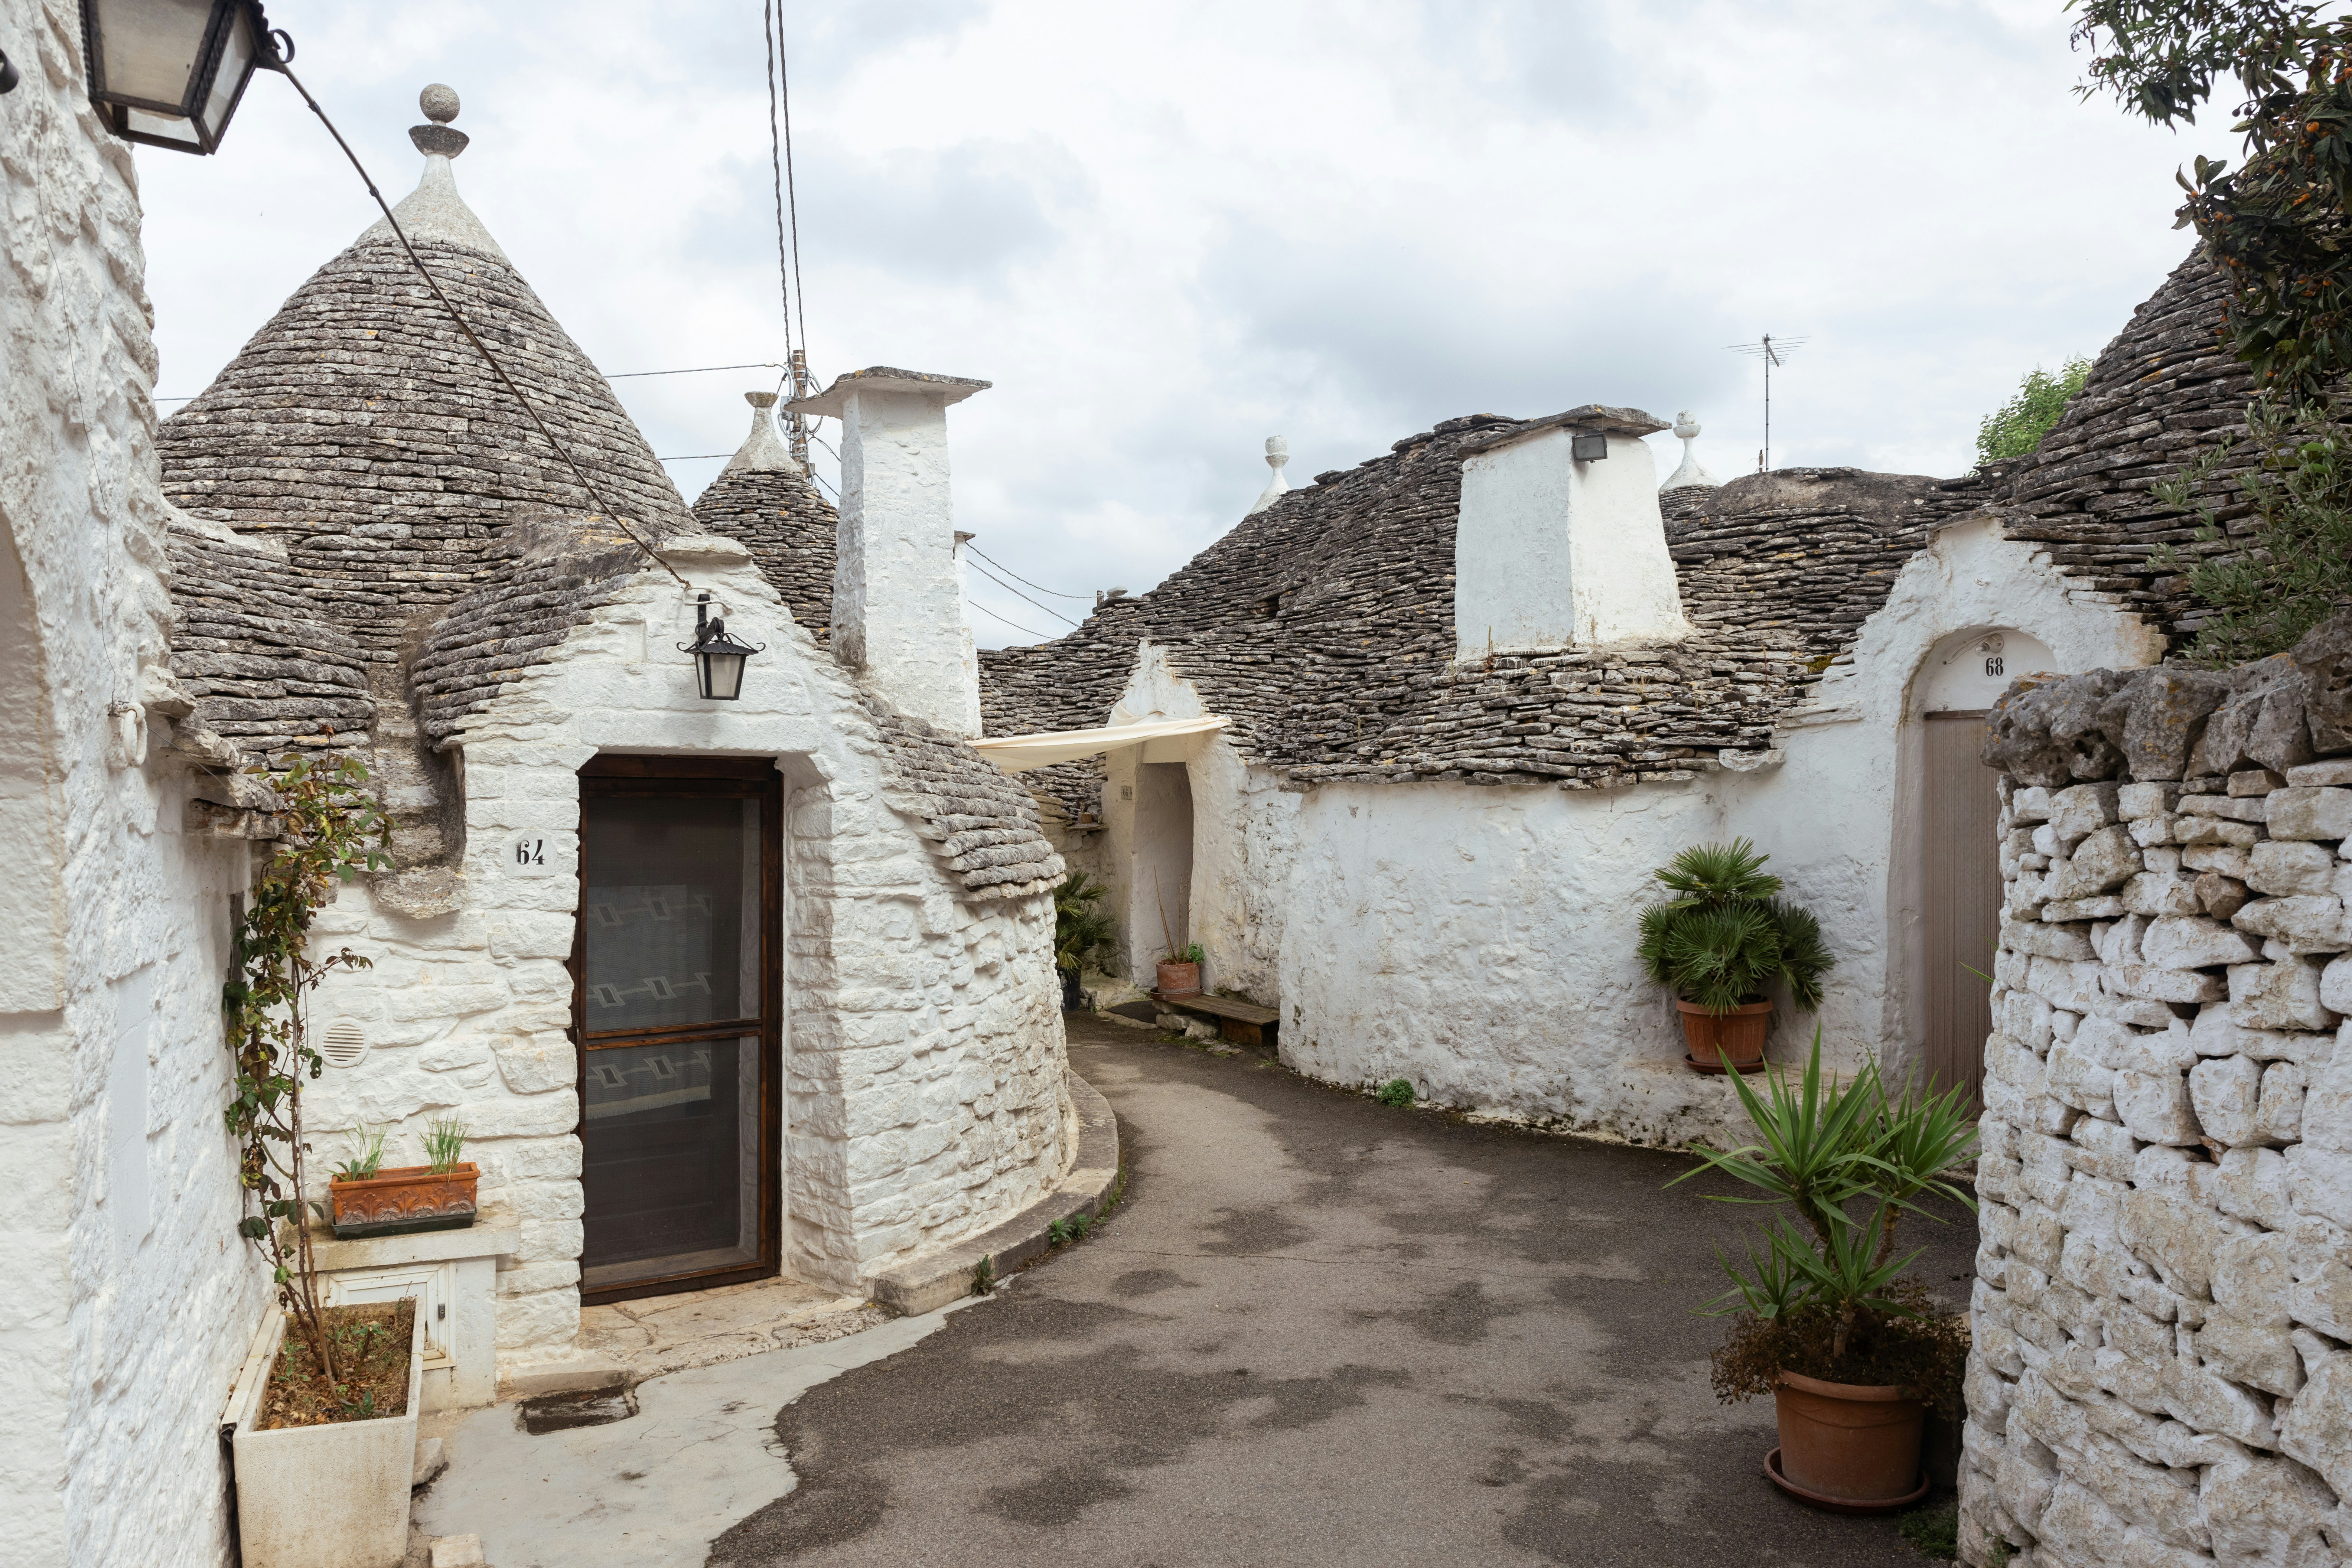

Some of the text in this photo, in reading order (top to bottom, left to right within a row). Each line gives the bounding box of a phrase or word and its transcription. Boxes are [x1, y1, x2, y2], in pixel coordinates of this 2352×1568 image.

[1985, 657, 2004, 677] 68
[1123, 788, 1128, 796] 66
[516, 839, 545, 865] 64
